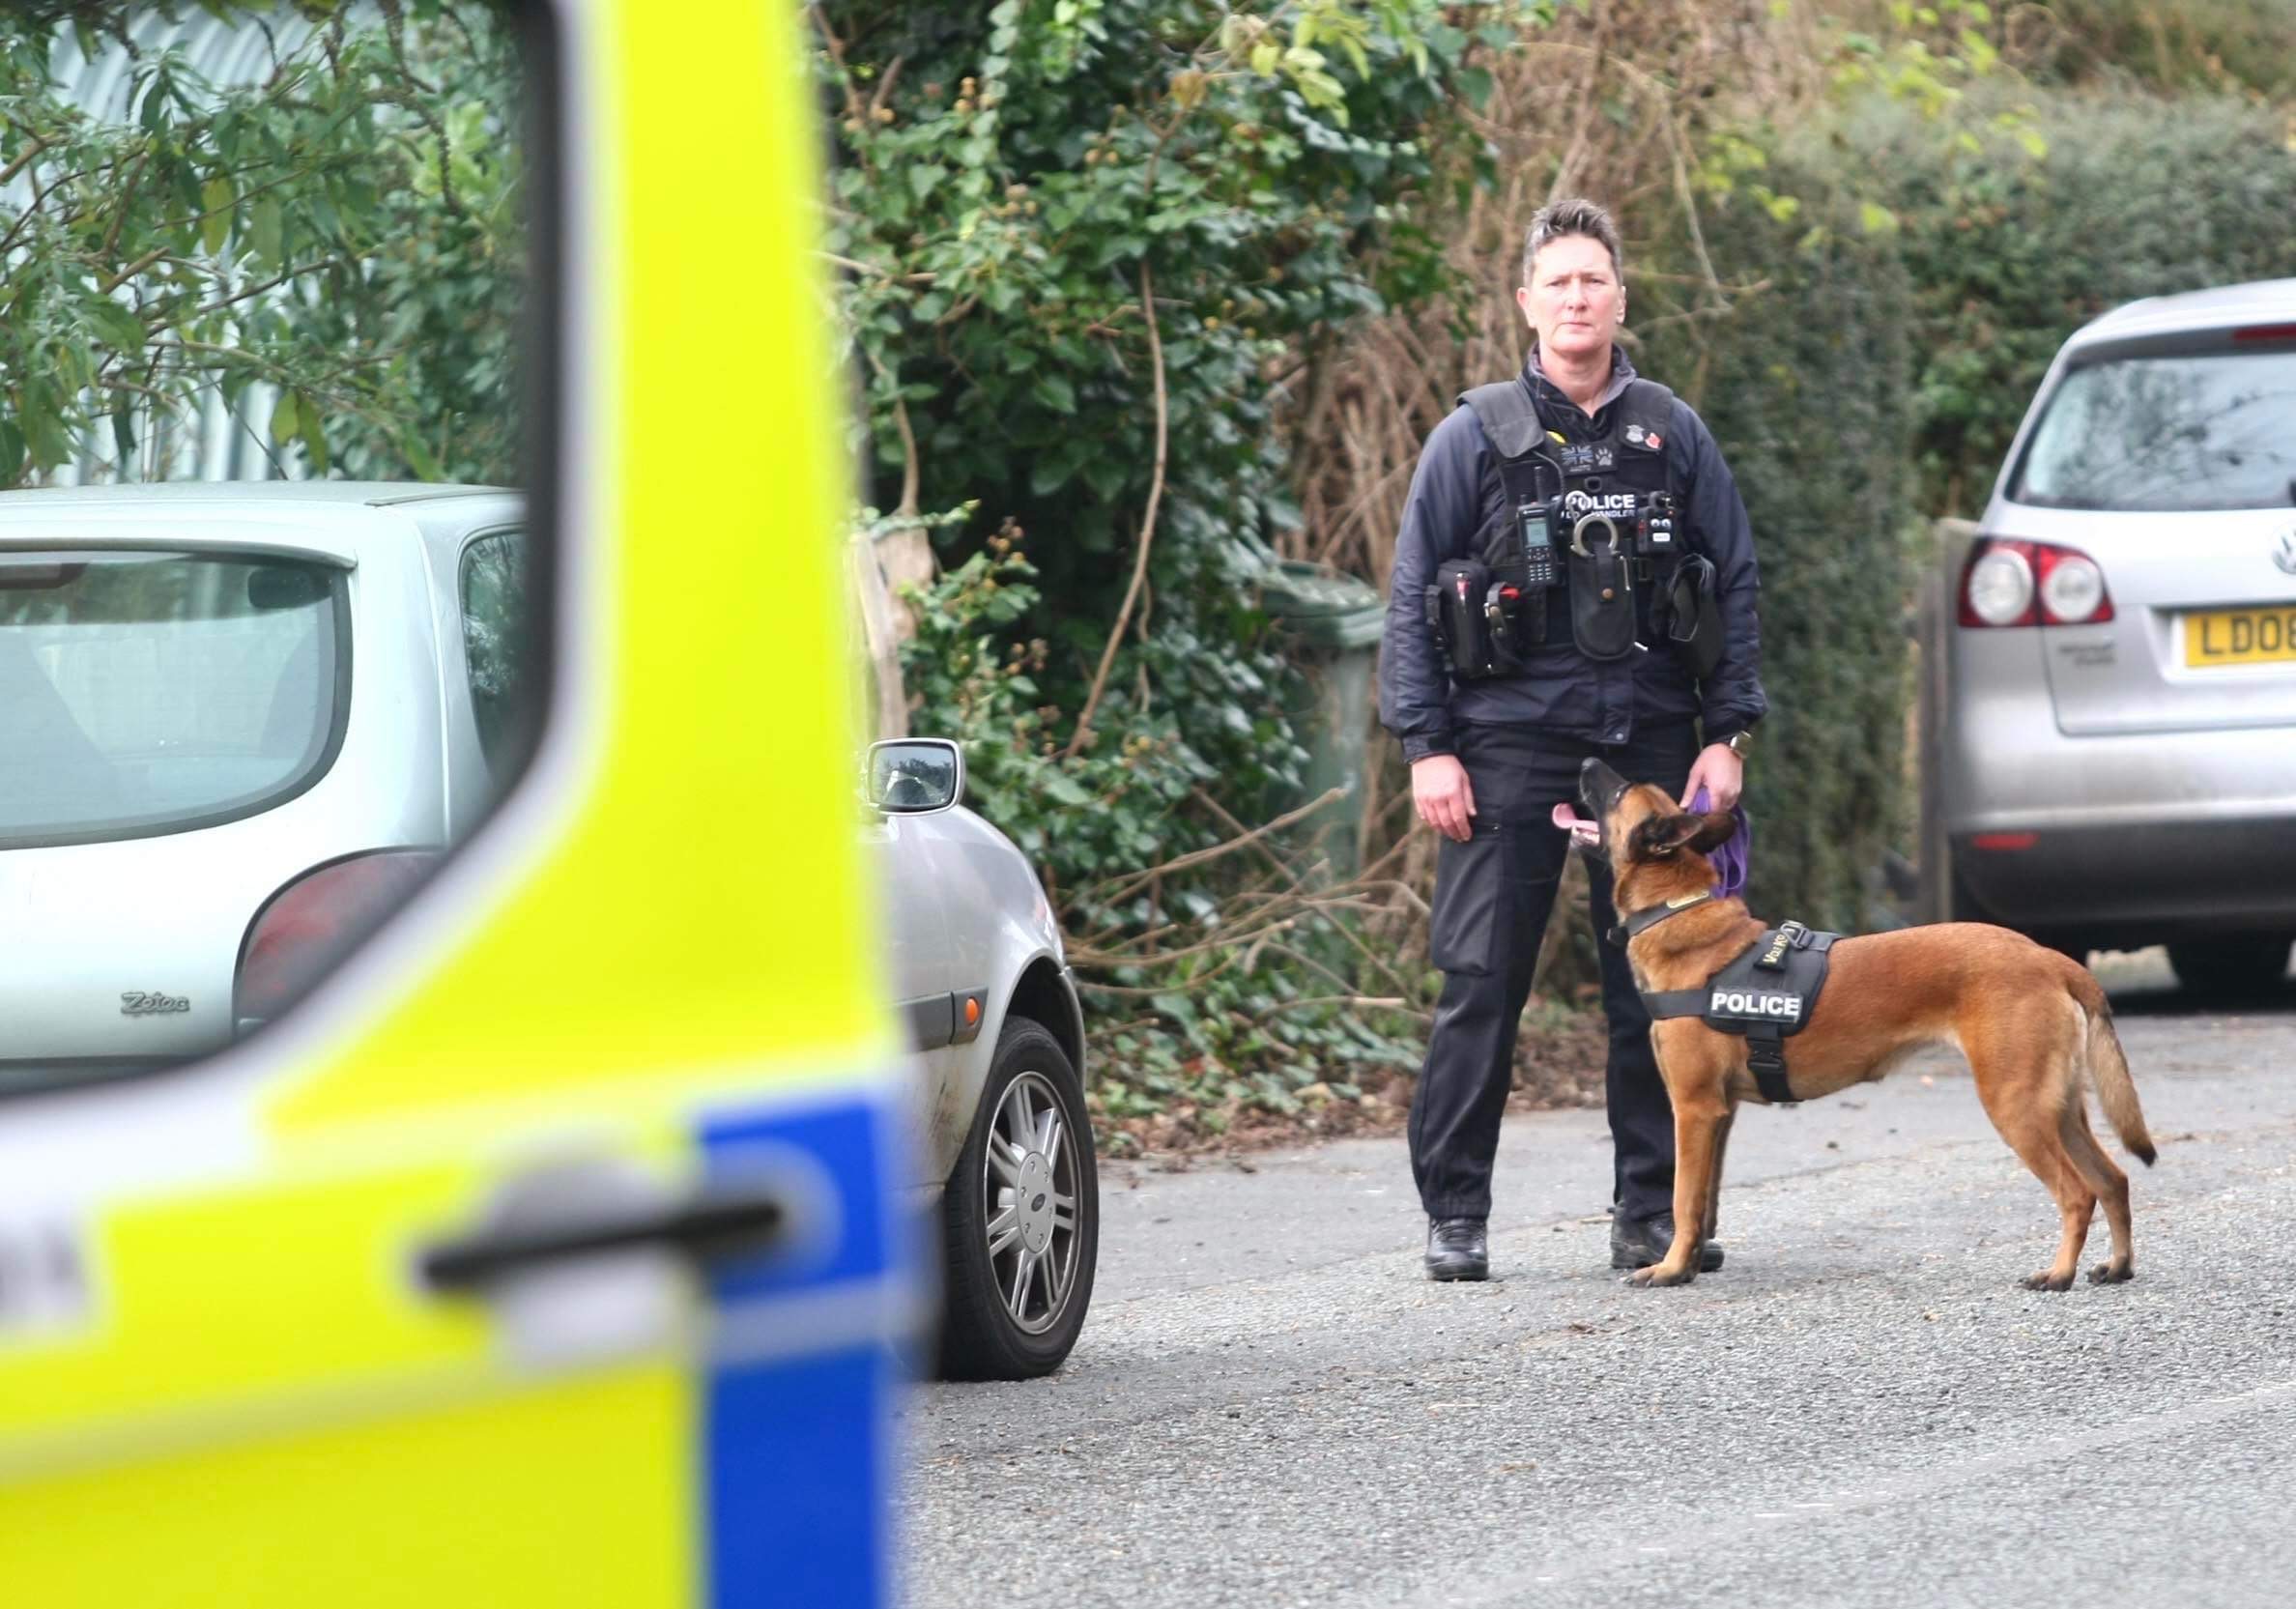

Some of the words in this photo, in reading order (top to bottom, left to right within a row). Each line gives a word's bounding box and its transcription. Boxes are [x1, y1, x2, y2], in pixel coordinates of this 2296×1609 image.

[1565, 494, 1636, 510] POLICE
[121, 991, 190, 1015] Zetec
[1711, 992, 1800, 1016] POLICE
